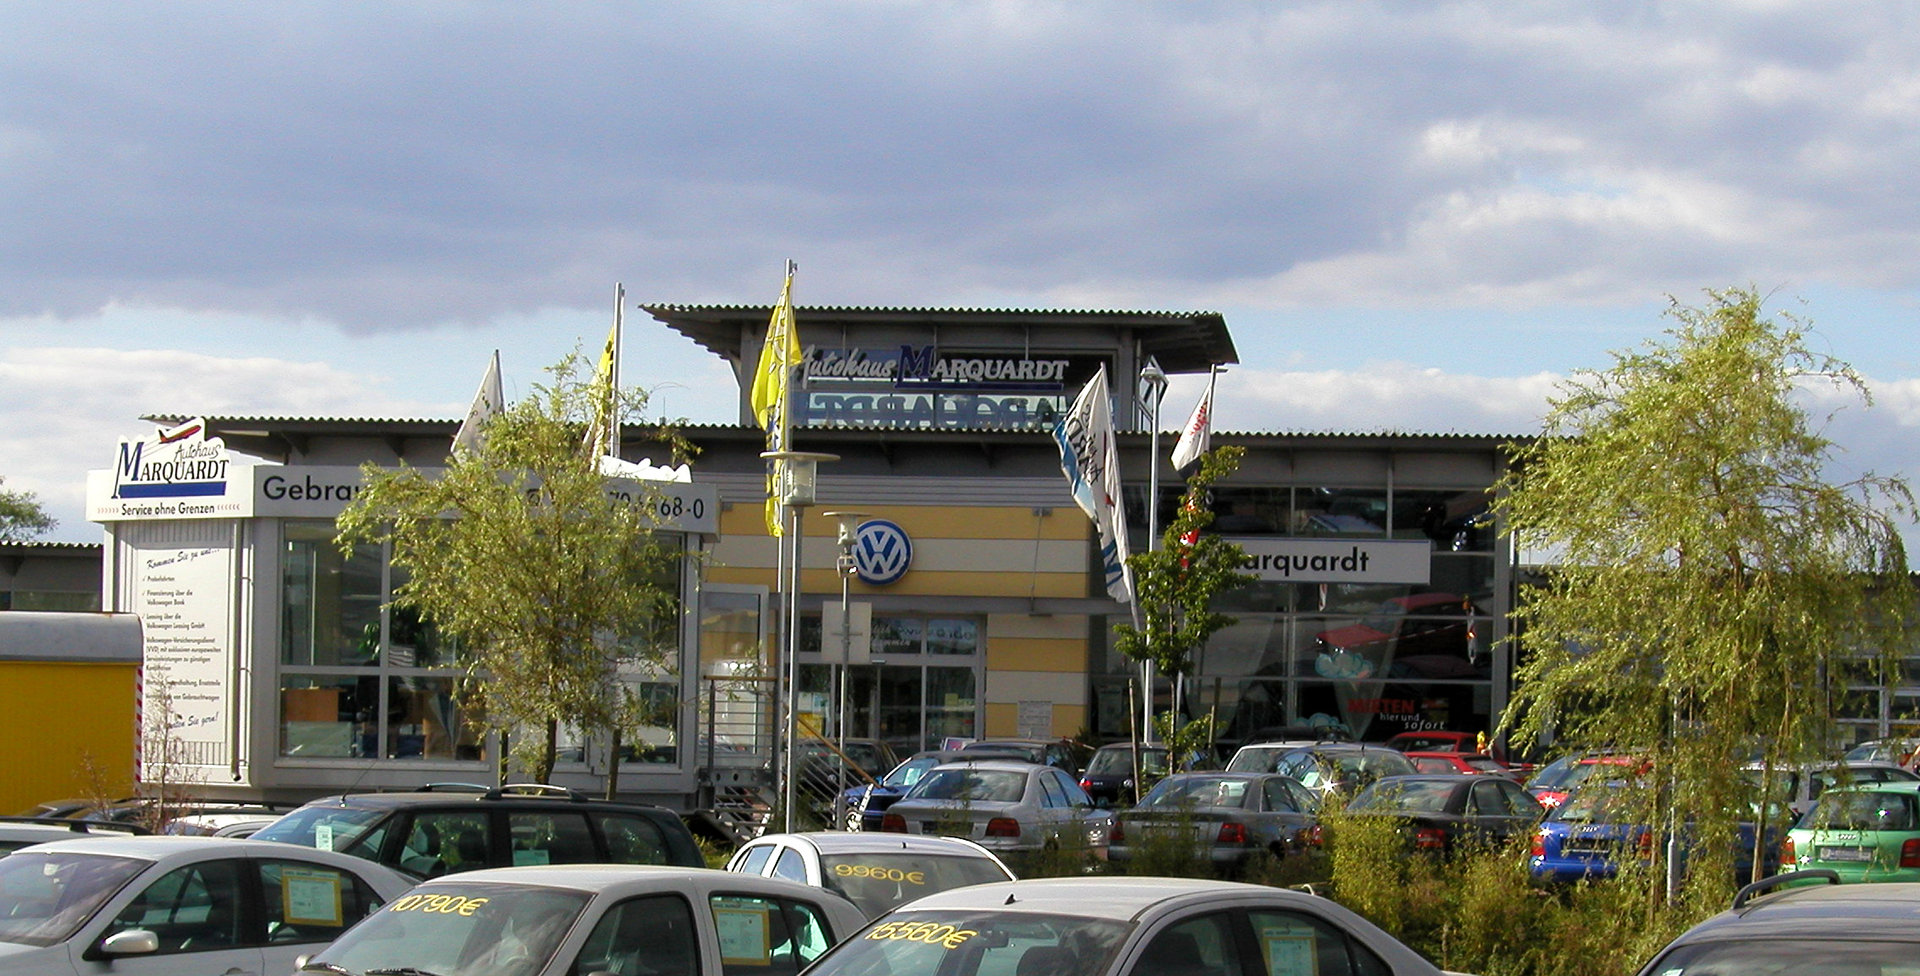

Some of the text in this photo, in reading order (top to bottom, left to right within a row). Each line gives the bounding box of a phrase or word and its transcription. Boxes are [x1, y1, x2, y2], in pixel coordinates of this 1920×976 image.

[793, 345, 1069, 389] Autohaus MARQUARDT
[174, 442, 221, 463] Autohaus
[111, 442, 229, 499] MARQUARDT
[263, 475, 360, 500] Gebra
[122, 502, 215, 516] Service ohne Grenzen
[147, 557, 175, 569] Kommen
[177, 551, 188, 563] Sie
[853, 521, 911, 583] VW
[1237, 546, 1370, 577] arquardt
[146, 589, 174, 597] Finanzierung
[147, 599, 172, 607] Volkswagen
[146, 613, 163, 621] Leasing
[146, 622, 172, 630] Volkswagen
[173, 622, 190, 630] Leasing
[1348, 698, 1415, 713] MIETEN
[188, 715, 199, 726] Sie
[1380, 713, 1420, 722] hier und
[1404, 720, 1444, 732] sofort
[835, 864, 925, 885] 9960€
[390, 895, 488, 916] 10790€
[865, 922, 977, 949] 15560€
